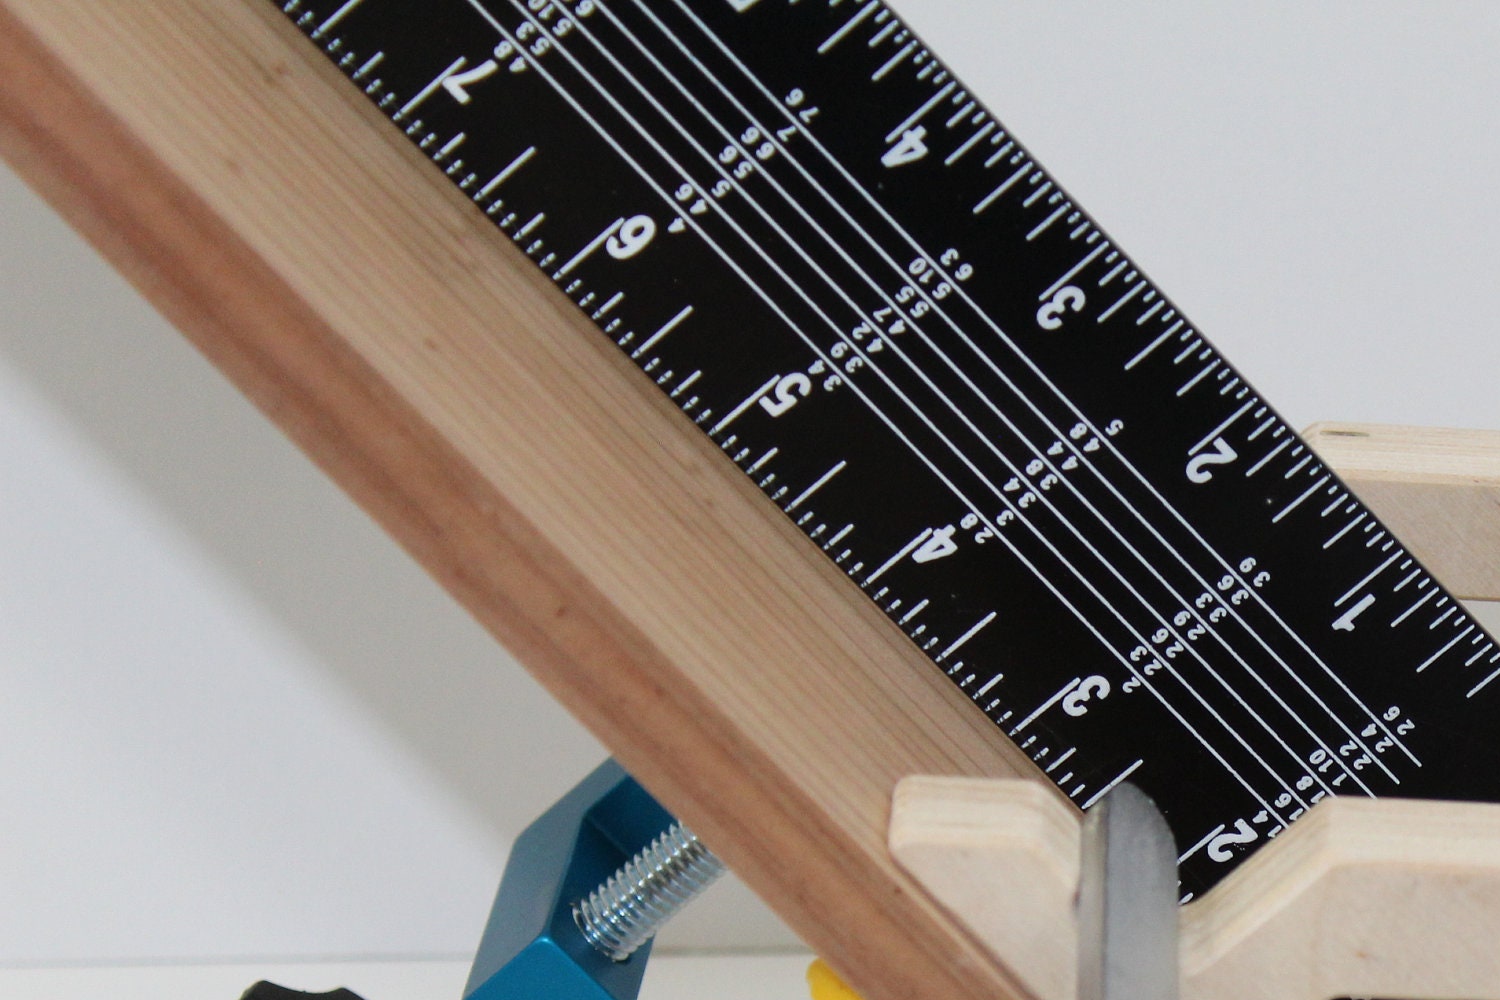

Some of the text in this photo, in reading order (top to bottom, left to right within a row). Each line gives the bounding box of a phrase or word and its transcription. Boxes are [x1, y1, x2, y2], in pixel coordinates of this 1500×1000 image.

[442, 59, 498, 105] 7
[880, 125, 928, 168] 4
[606, 215, 656, 260] 6
[1036, 285, 1086, 330] 3
[758, 372, 812, 418] 5
[1185, 436, 1238, 484] 2
[911, 524, 958, 564] 4
[1331, 593, 1376, 632] 1
[1062, 674, 1111, 717] 3
[1207, 818, 1259, 863] 2
